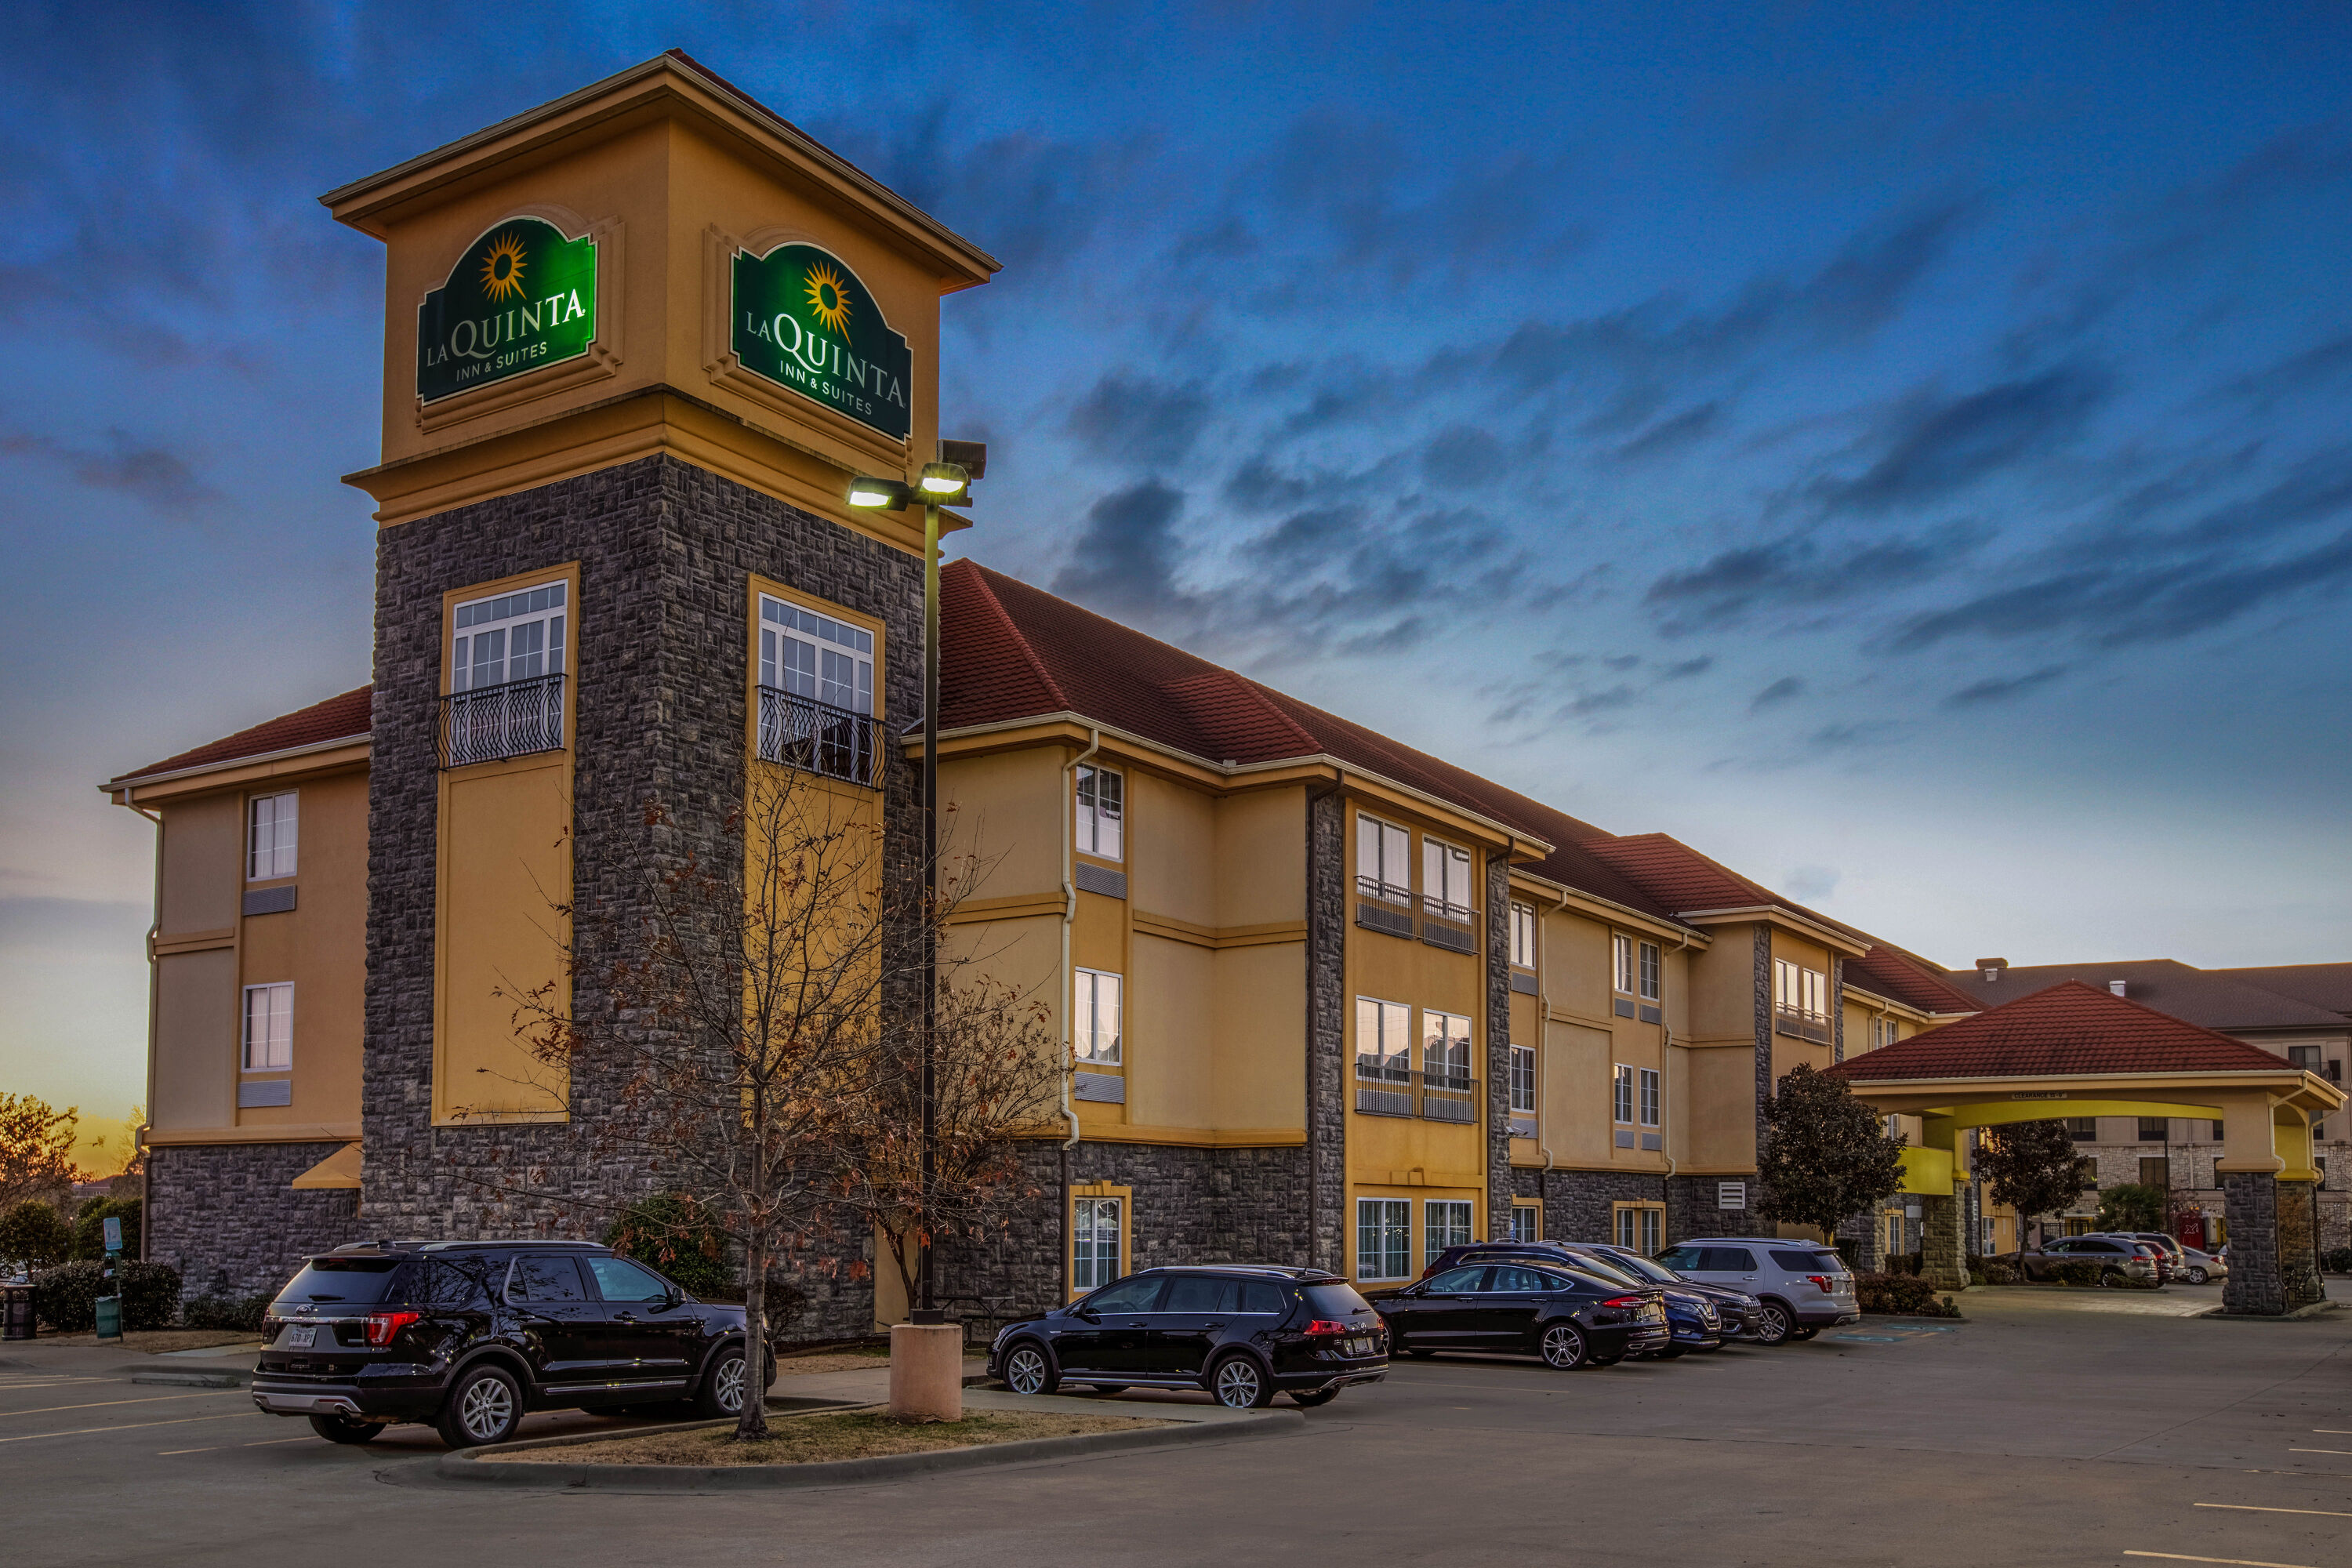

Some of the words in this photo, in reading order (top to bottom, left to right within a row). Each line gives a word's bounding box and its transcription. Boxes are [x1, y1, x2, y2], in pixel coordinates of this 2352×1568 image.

[426, 343, 449, 367] LA
[451, 289, 586, 359] QUINTA
[456, 363, 480, 382] INN
[485, 361, 492, 373] &
[496, 341, 548, 368] SUITES
[746, 310, 772, 343] LA
[773, 313, 906, 409] QUINTA
[780, 360, 806, 384] INN
[810, 377, 818, 390] &
[822, 381, 872, 416] SUITES
